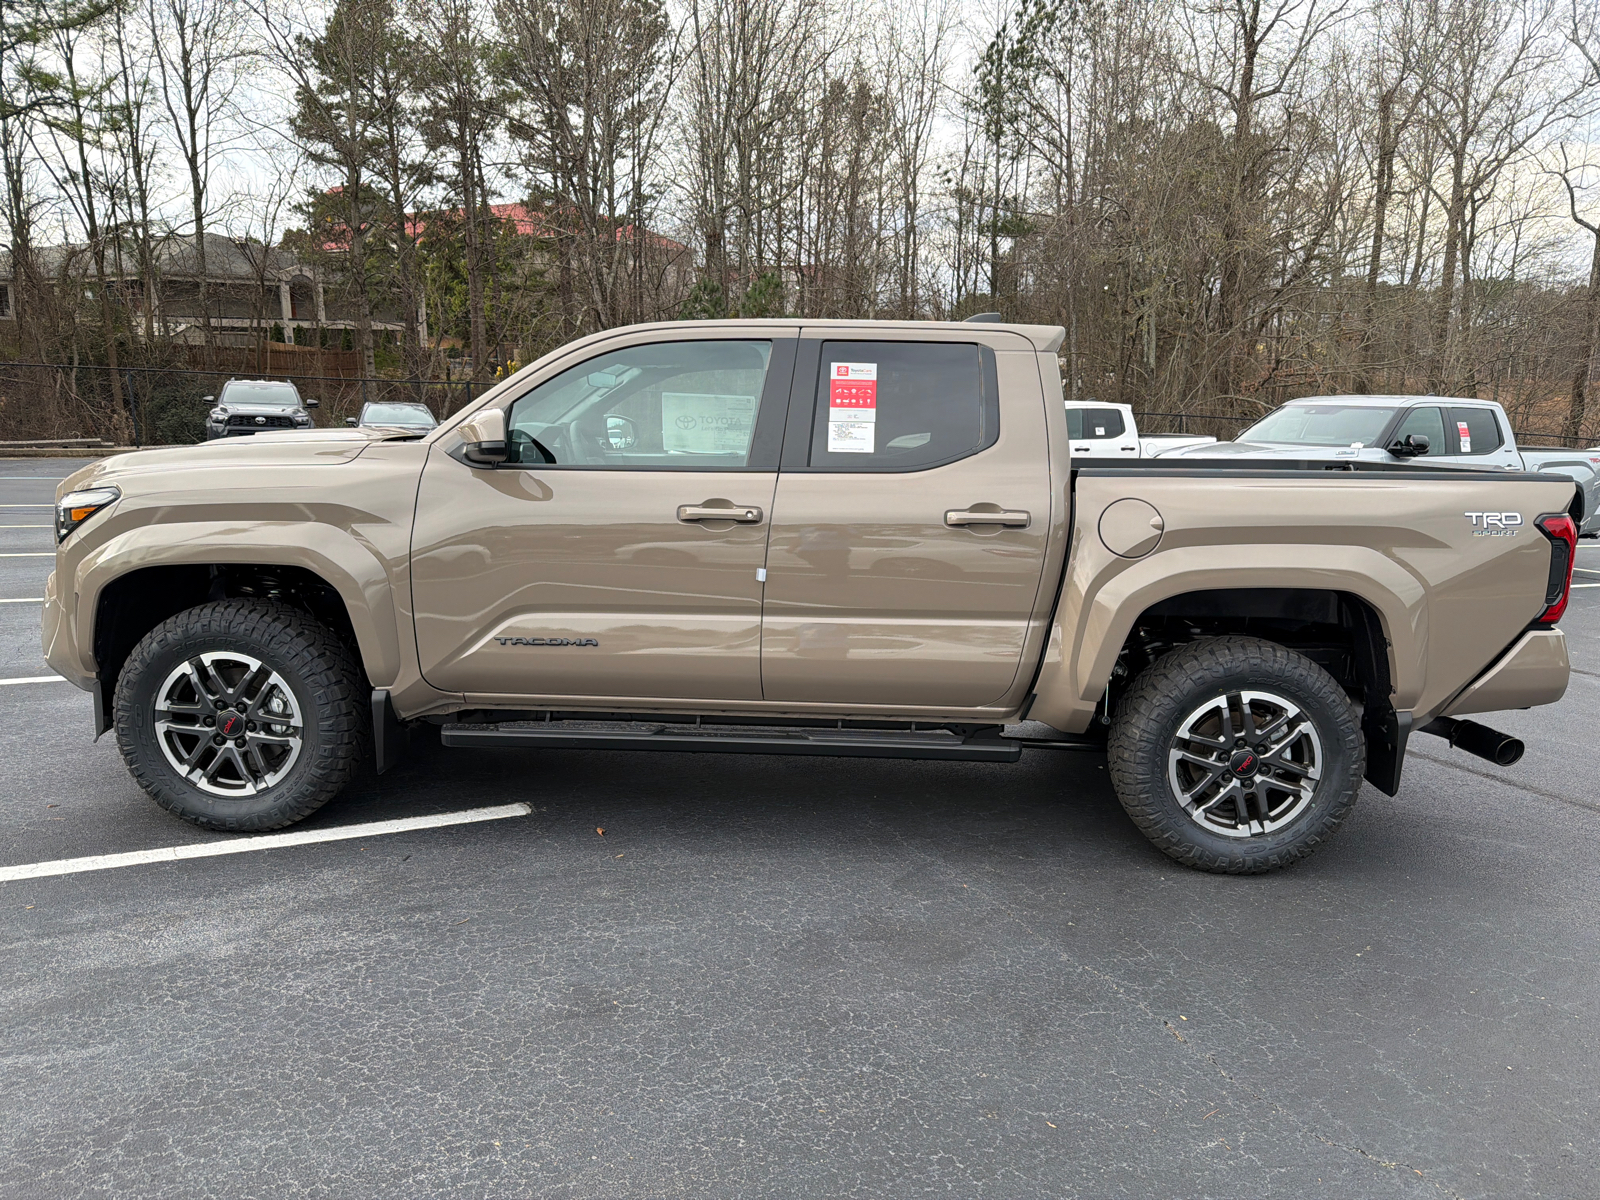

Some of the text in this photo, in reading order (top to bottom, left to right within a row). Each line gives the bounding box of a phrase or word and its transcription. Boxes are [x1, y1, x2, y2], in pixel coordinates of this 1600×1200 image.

[699, 415, 742, 425] TOYOTA
[1464, 512, 1523, 529] TRD
[172, 637, 215, 657] RIDGE
[494, 636, 599, 647] TACOMA
[223, 716, 237, 734] TRD
[1236, 755, 1254, 772] TRD
